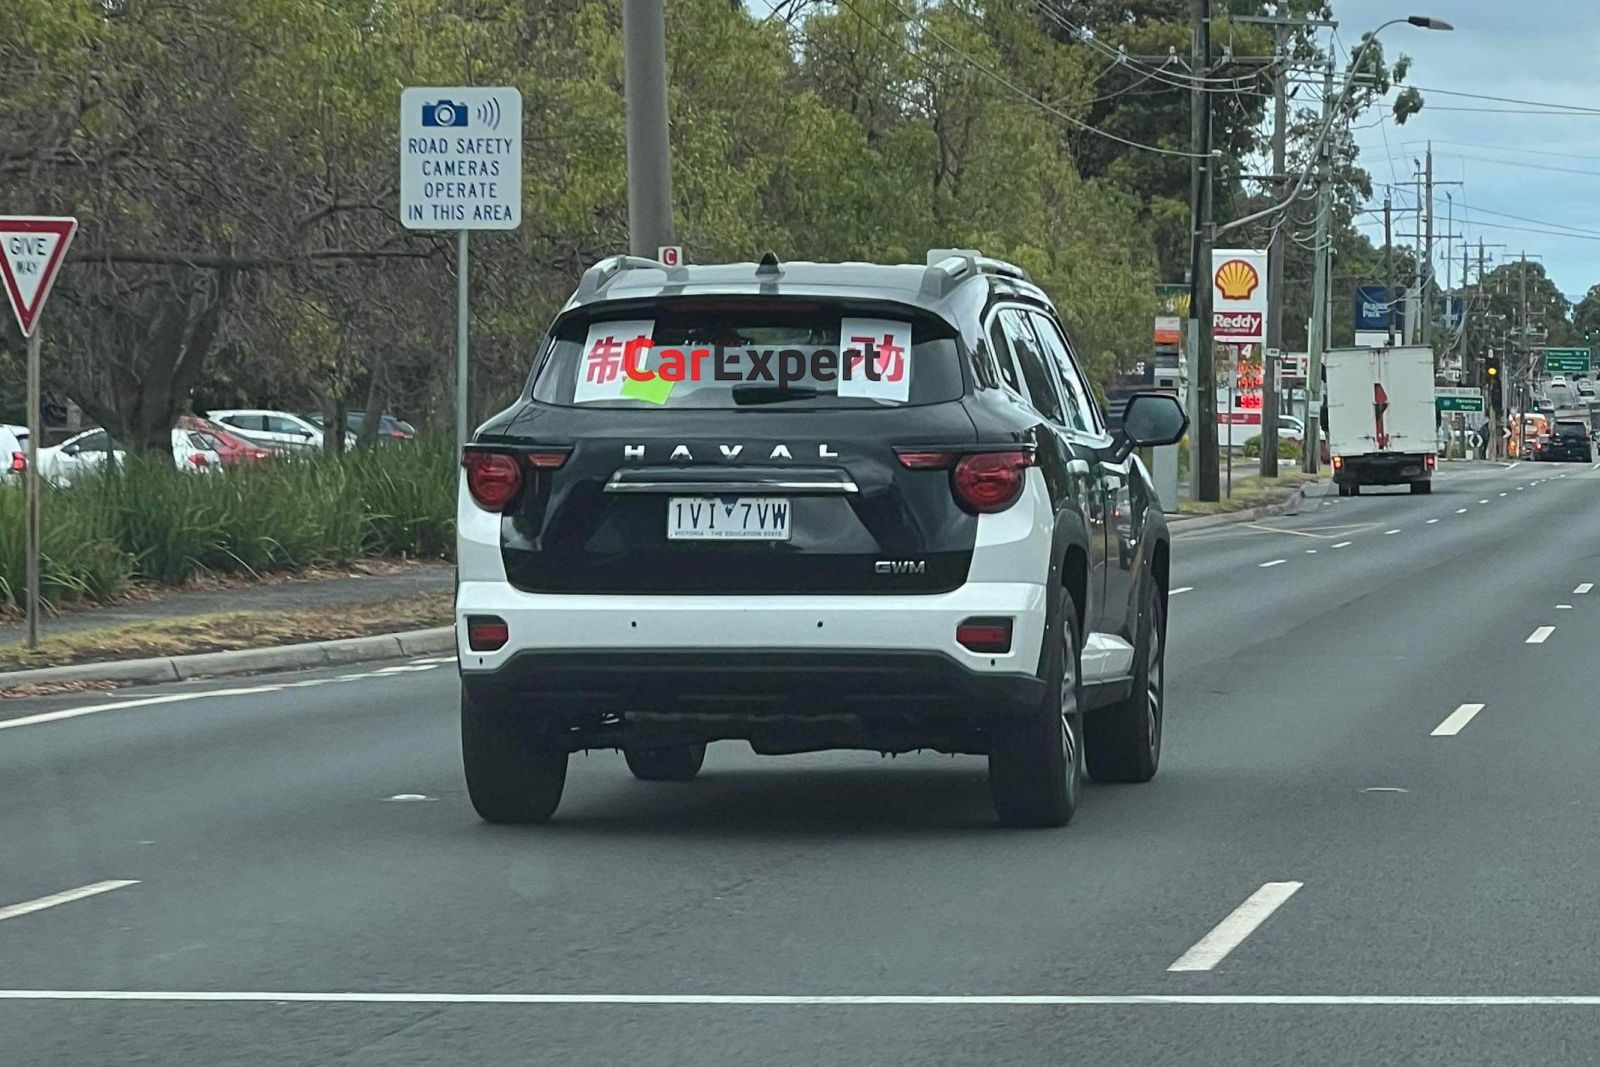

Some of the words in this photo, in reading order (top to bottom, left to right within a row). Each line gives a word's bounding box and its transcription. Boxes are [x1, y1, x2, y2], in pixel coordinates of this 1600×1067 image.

[408, 138, 448, 154] ROAD
[456, 138, 512, 154] SAFETY
[422, 160, 500, 176] CAMERAS
[424, 182, 498, 198] OPERATE
[408, 204, 423, 220] IN
[432, 204, 465, 220] THIS
[473, 204, 512, 220] AREA
[9, 236, 46, 256] GIVE
[16, 260, 39, 275] WAY
[1213, 313, 1261, 334] Reddy
[624, 444, 839, 461] HAVAL
[874, 560, 925, 574] GWM
